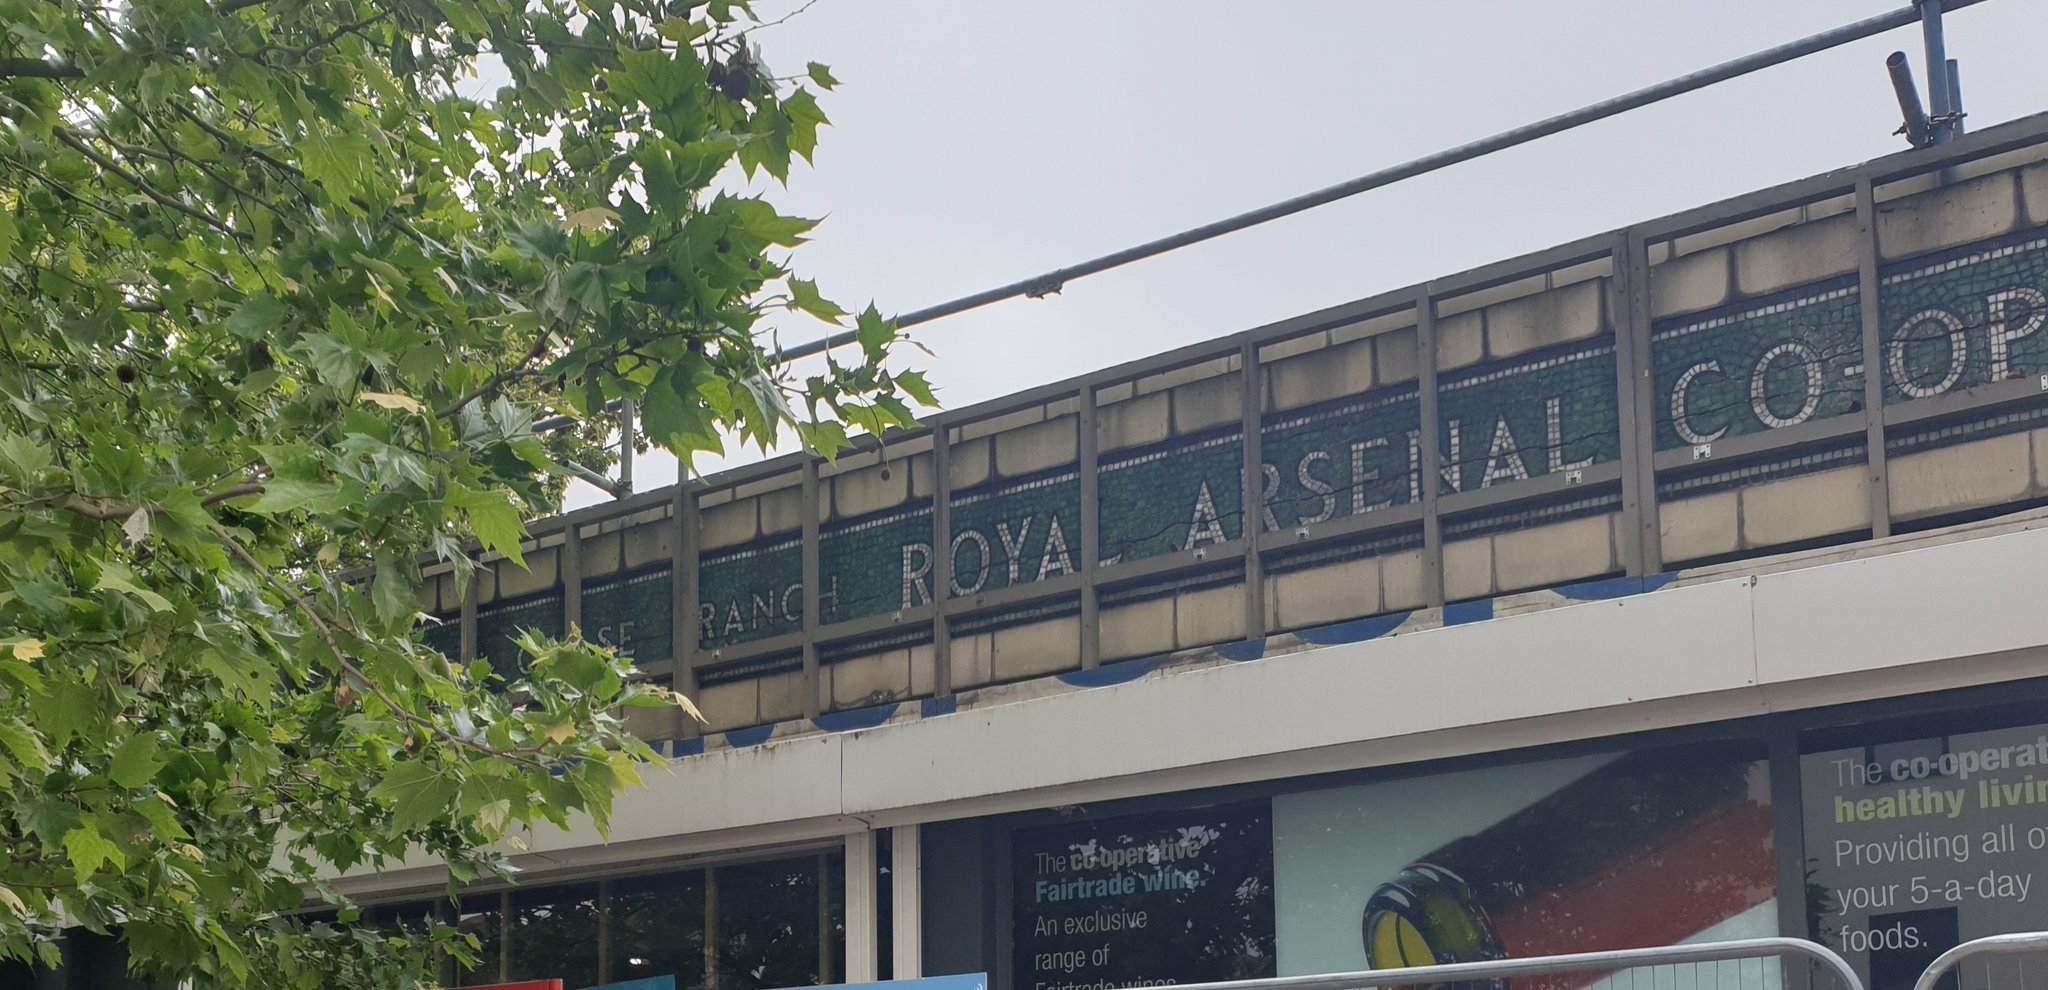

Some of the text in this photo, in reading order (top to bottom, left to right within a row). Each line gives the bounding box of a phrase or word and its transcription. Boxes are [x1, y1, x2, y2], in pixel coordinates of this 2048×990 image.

[699, 575, 838, 640] RANCH
[1183, 397, 1594, 551] ARSENAL
[1831, 758, 1883, 787] The
[1833, 786, 1966, 824] healthy
[1034, 838, 1200, 875] The co-operative
[1835, 823, 2048, 867] Providing all o
[1035, 868, 1207, 903] Fairtrade wine.
[1837, 869, 2032, 915] your 5-a-day
[1034, 908, 1147, 938] An exclusive
[1839, 921, 1928, 953] foods.
[1035, 943, 1110, 973] range of
